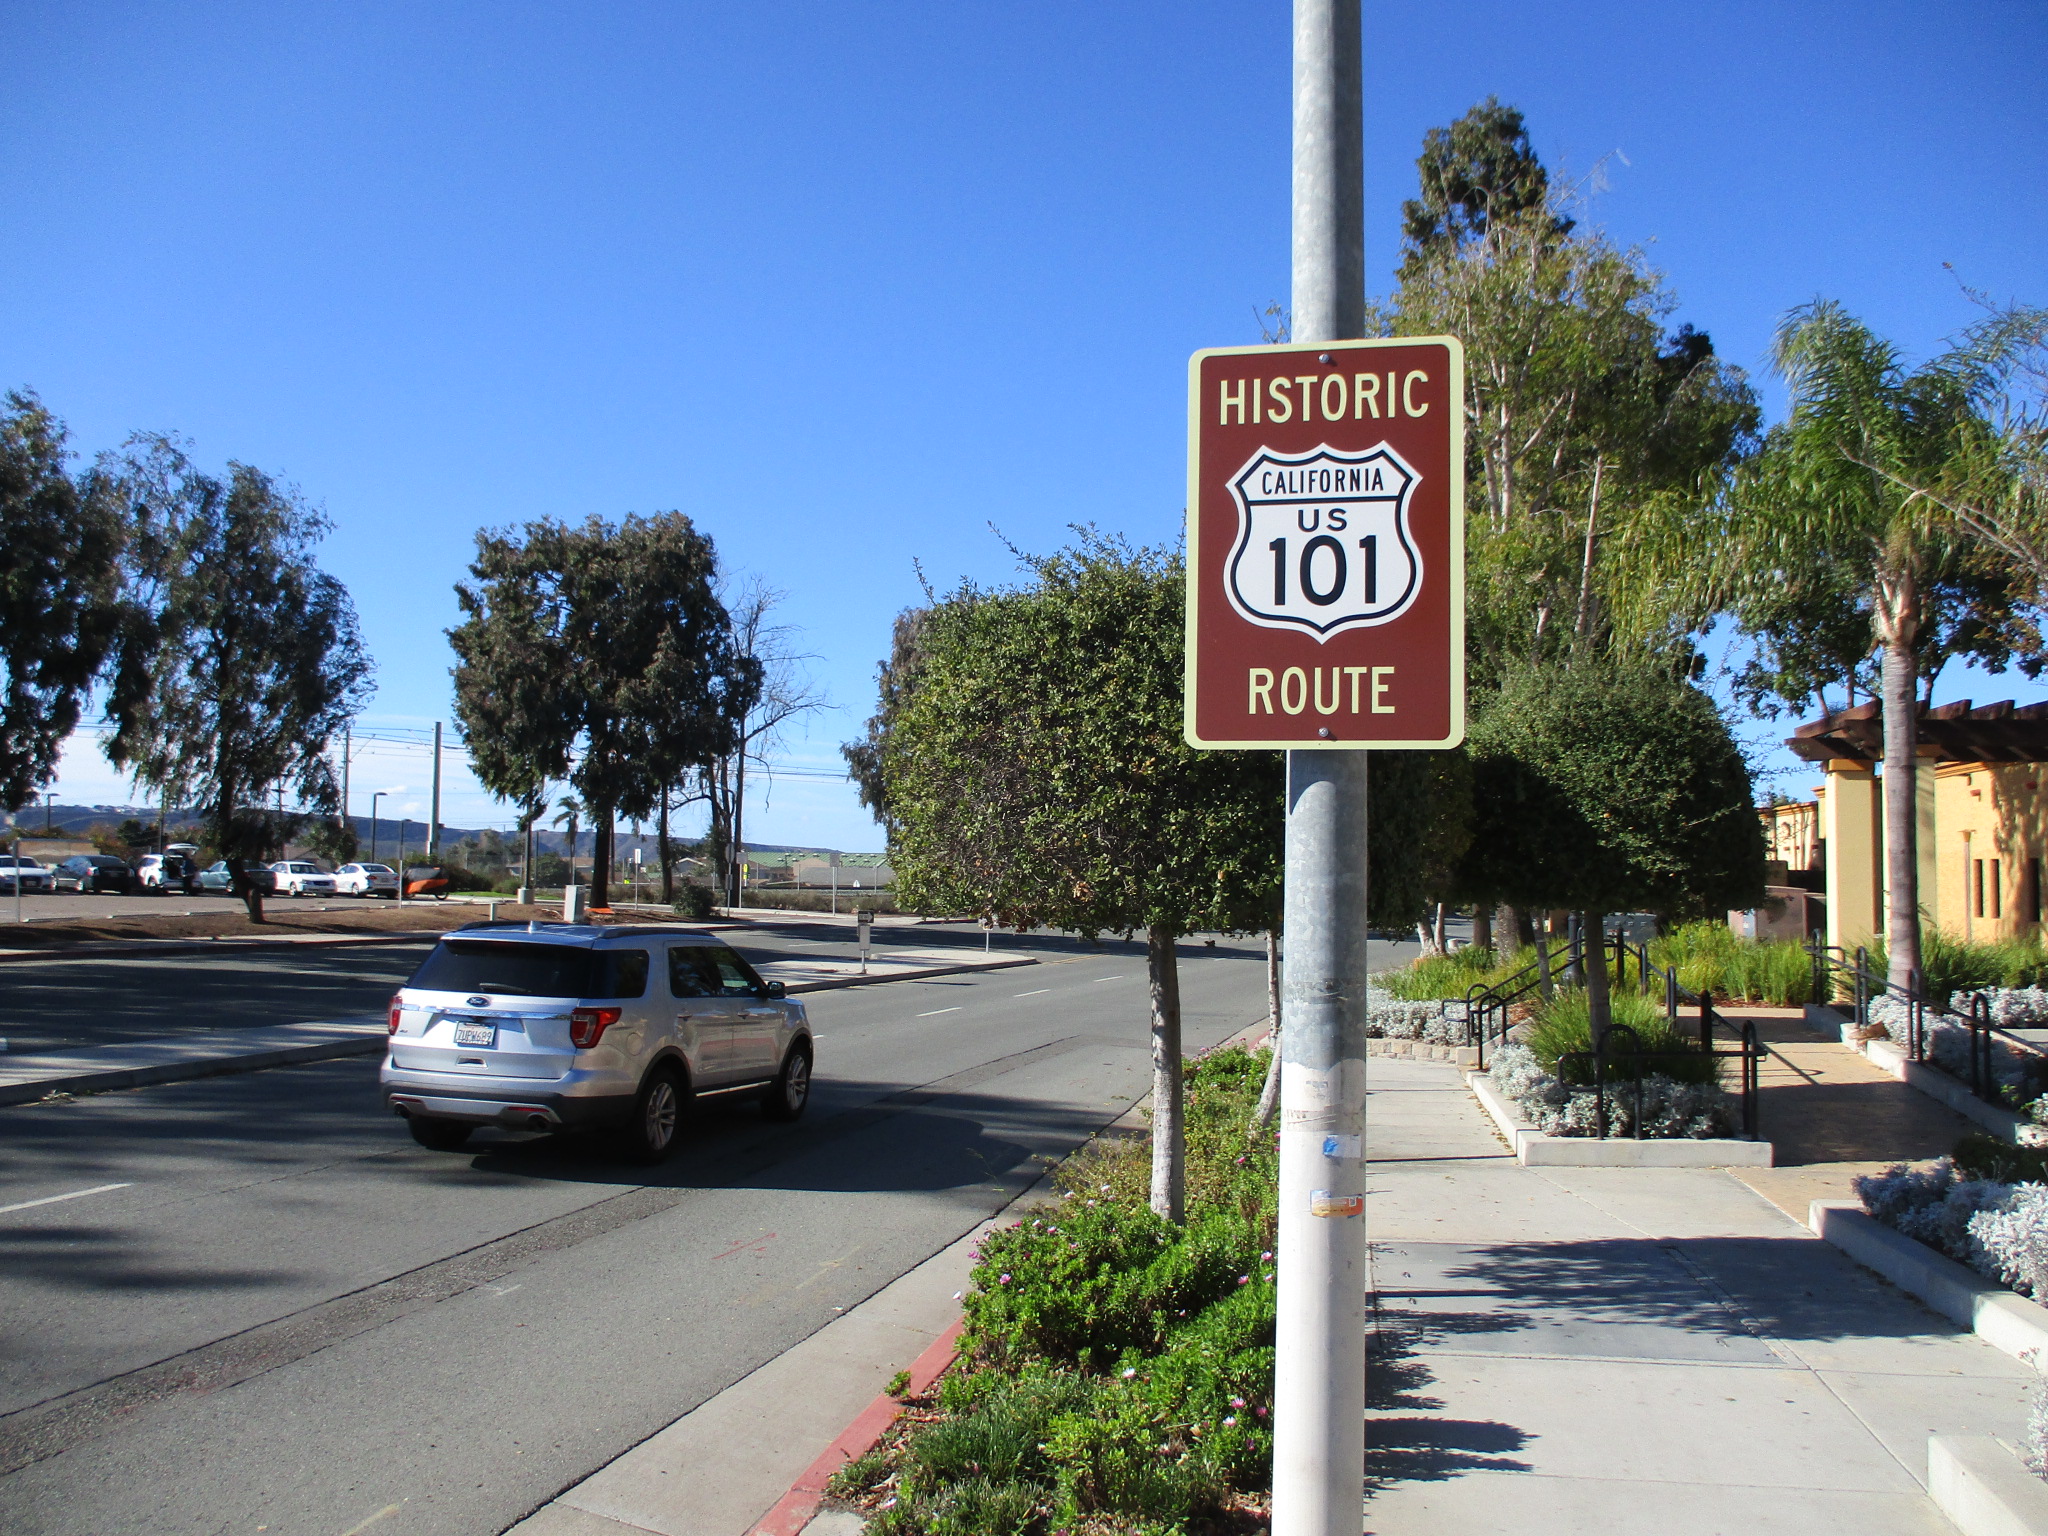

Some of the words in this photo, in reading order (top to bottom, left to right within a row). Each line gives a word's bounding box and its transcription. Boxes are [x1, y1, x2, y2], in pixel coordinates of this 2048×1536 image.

[1220, 370, 1429, 425] HISTORIC
[1262, 467, 1384, 495] CALIFORNIA
[1297, 508, 1347, 532] US
[1269, 535, 1377, 606] 101
[1248, 666, 1396, 715] ROUTE
